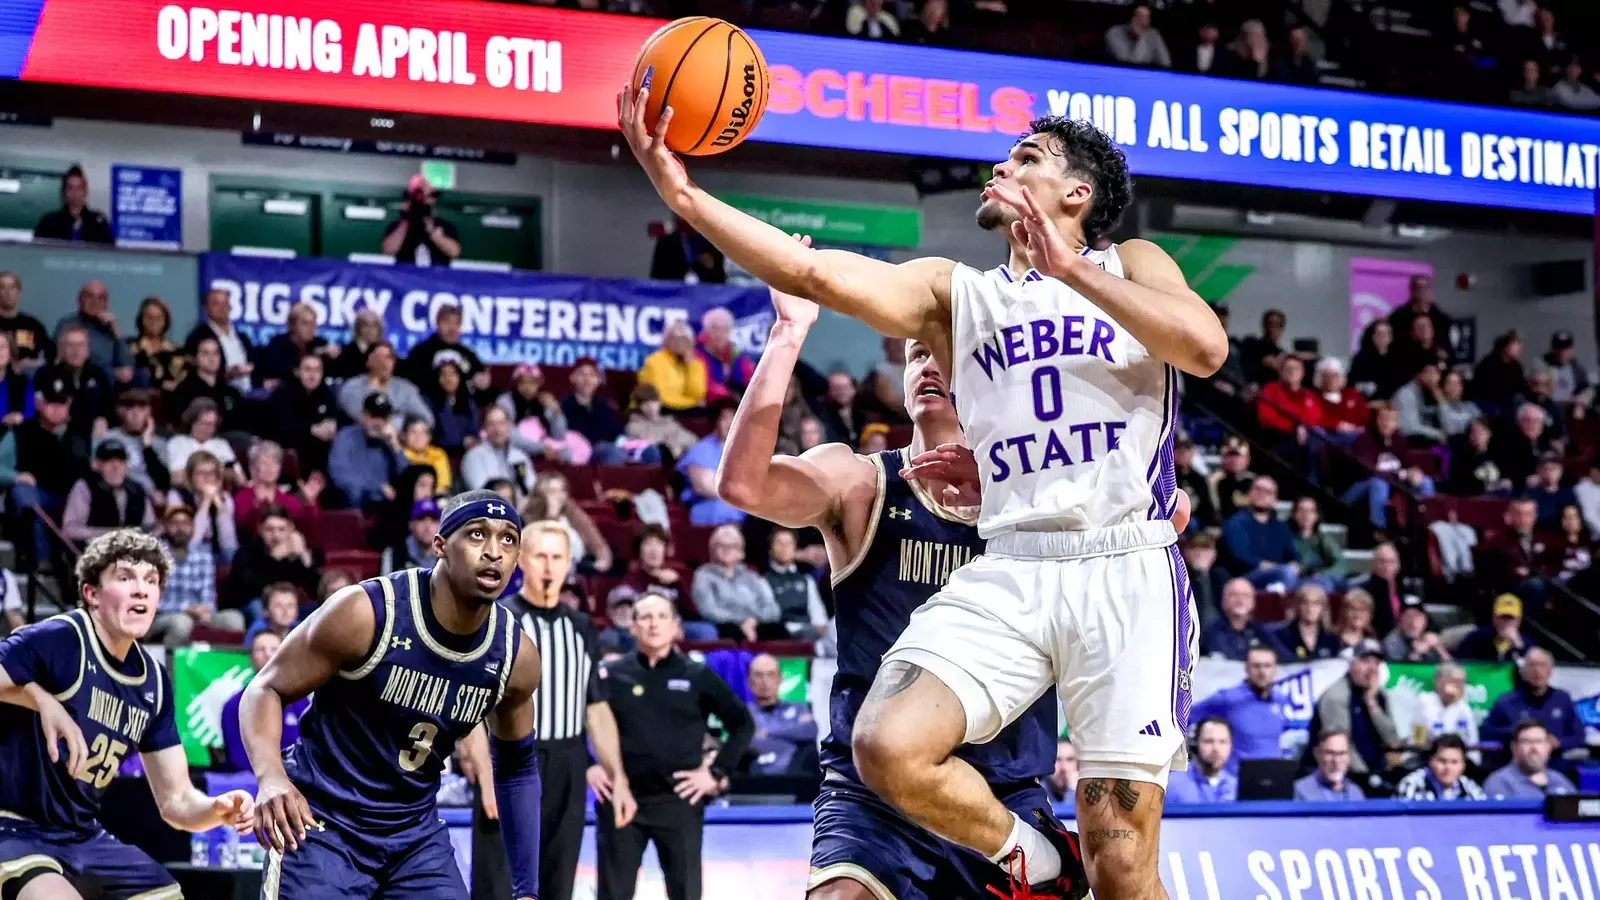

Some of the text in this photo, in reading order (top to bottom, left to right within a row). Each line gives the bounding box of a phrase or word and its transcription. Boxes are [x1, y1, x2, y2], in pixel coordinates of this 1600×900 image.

[157, 5, 562, 93] OPENING APRIL 6TH
[711, 64, 756, 147] Wilson
[767, 64, 1036, 136] SCHEELS
[1047, 89, 1600, 190] YOUR ALL SPORTS RETAIL DESTINAT
[210, 279, 291, 326] BIG
[300, 284, 392, 327] SKY
[972, 315, 1117, 382] WEBER
[1031, 365, 1064, 422] 0
[989, 421, 1127, 483] STATE
[87, 685, 150, 744] MONTANA STATE
[380, 664, 492, 724] MONTANA STATE
[76, 732, 129, 790] 25
[398, 721, 439, 772] 3
[1247, 846, 1443, 900] SPORTS
